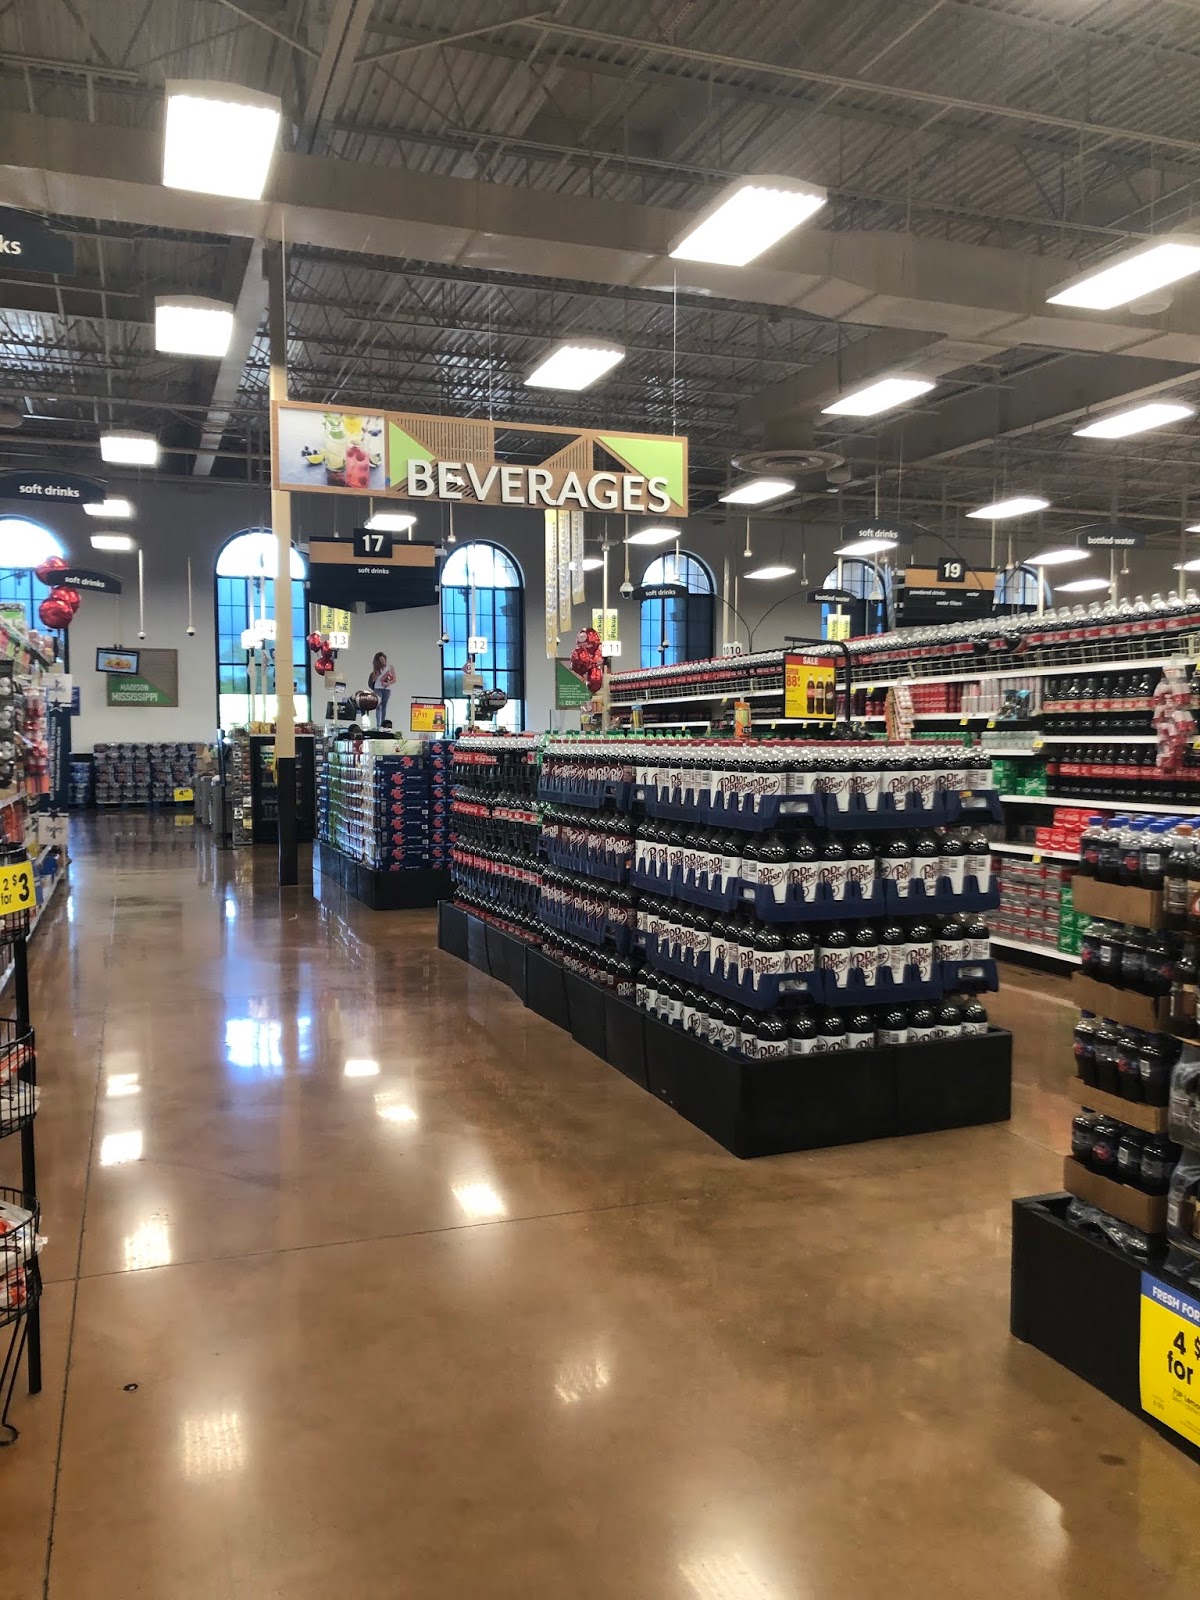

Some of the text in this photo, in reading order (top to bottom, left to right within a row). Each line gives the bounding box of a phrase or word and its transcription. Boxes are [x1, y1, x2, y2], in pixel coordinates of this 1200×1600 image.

[19, 483, 80, 498] soft drinks
[407, 458, 670, 513] BEVERAGES
[858, 528, 898, 539] soft drinks
[362, 533, 384, 552] 17
[1087, 535, 1136, 546] bottled water
[371, 567, 389, 575] drinks
[943, 562, 961, 578] 19
[64, 575, 105, 588] soft drinks
[645, 588, 676, 597] soft drinks
[333, 636, 346, 645] 13
[473, 640, 485, 650] 12
[609, 644, 619, 653] 11
[730, 646, 741, 655] 10
[802, 656, 819, 666] SALE
[120, 683, 149, 691] MADISON
[111, 692, 158, 702] MISSISSIPPI
[762, 867, 775, 876] Dr
[800, 866, 812, 876] Dr
[831, 865, 842, 875] Dr
[858, 864, 869, 874] Dr
[3, 878, 9, 891] 2
[1, 893, 12, 906] for
[830, 951, 842, 961] Dr
[865, 950, 876, 959] Dr
[761, 957, 773, 966] Dr
[1152, 1285, 1200, 1323] FRESH FOR
[1173, 1331, 1187, 1356] 4
[1167, 1350, 1194, 1386] for
